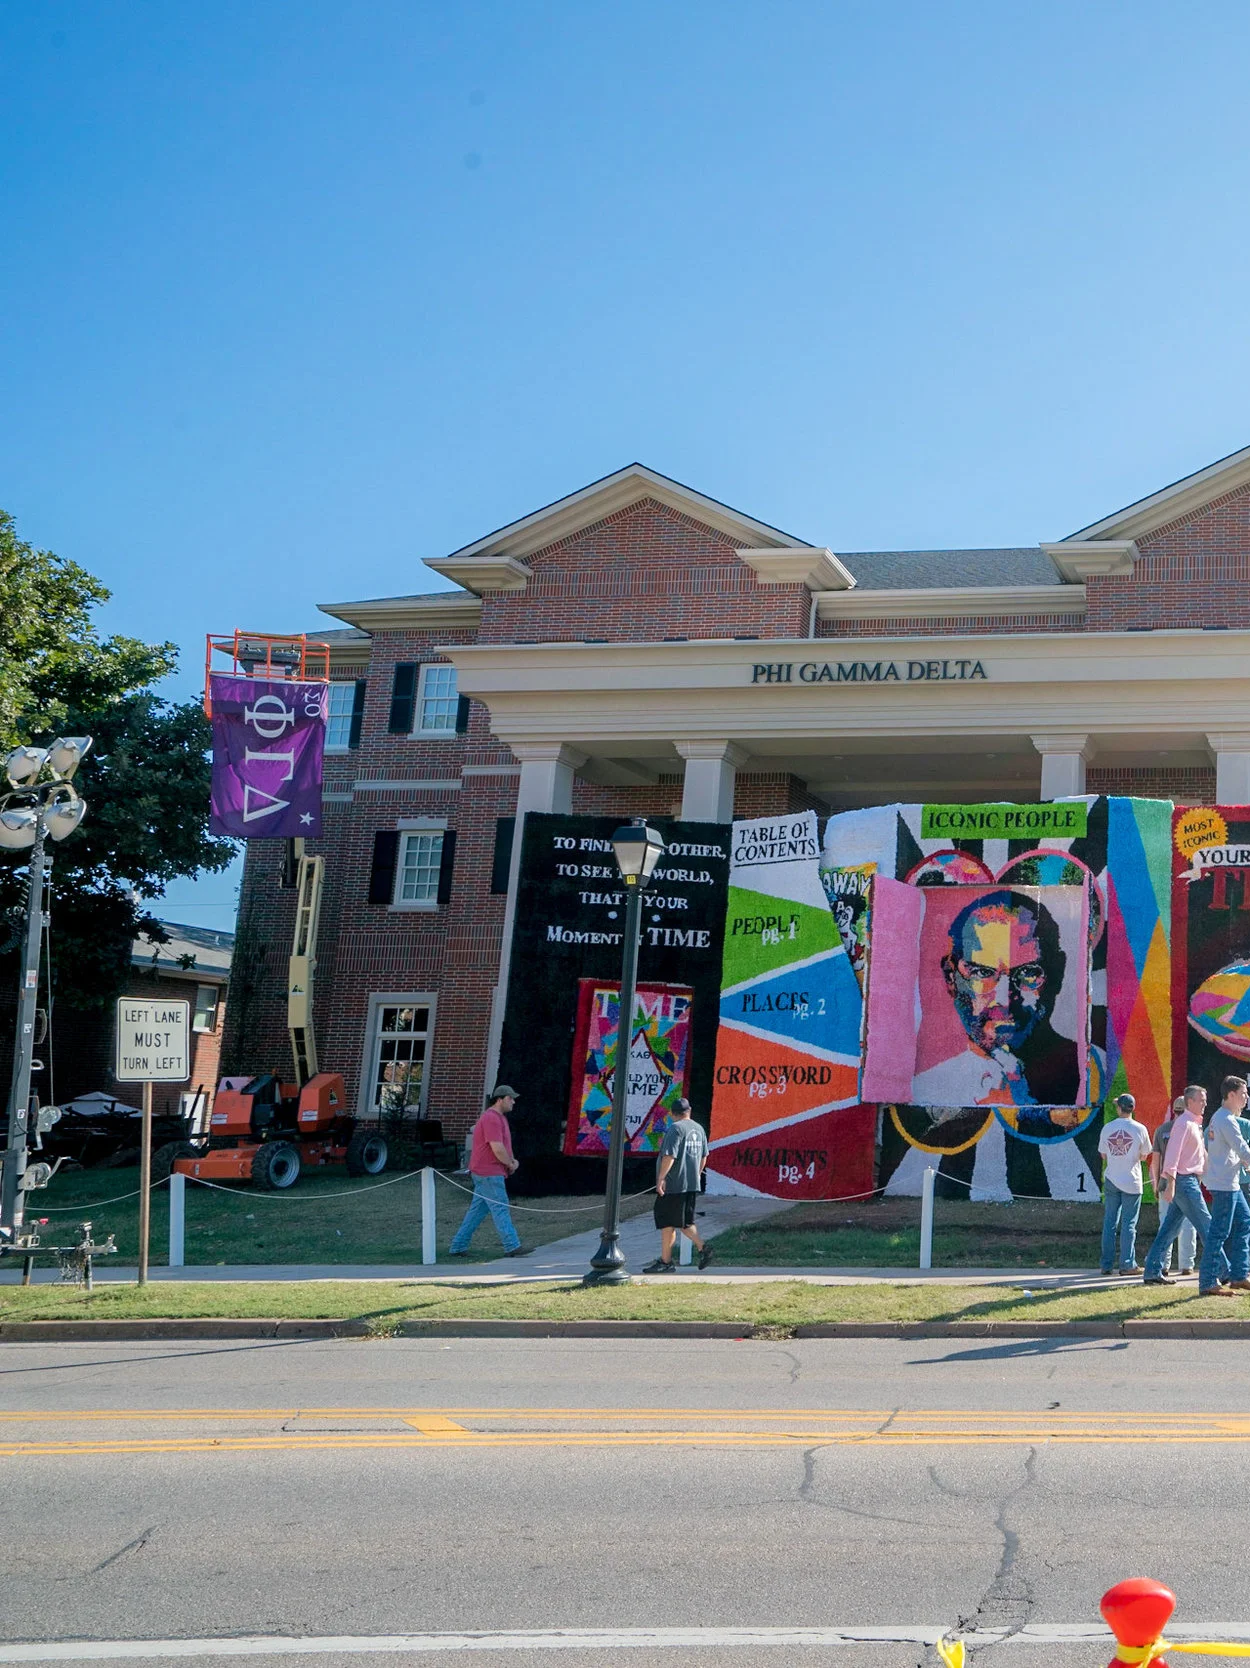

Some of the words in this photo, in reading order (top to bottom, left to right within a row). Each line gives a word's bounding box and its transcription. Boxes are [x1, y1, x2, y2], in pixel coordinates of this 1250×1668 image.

[752, 664, 793, 683] PHI
[799, 661, 900, 682] GAMMA
[906, 660, 987, 680] DELTA
[929, 811, 999, 829] ICONIC
[1004, 810, 1076, 828] PEOPLE
[1184, 818, 1215, 835] MOST
[740, 825, 787, 844] TABLE
[791, 821, 810, 838] OF
[1183, 830, 1221, 848] ICONIC
[553, 837, 576, 850] TO
[668, 843, 727, 860] OTHER,
[735, 838, 815, 862] CONTENTS
[556, 864, 578, 877] TO
[581, 865, 612, 879] SEE
[652, 869, 714, 885] WORLD,
[579, 892, 623, 905] THAT
[644, 896, 689, 910] YOUR
[732, 914, 800, 936] PEOPLE
[647, 927, 710, 948] TIME
[594, 989, 690, 1023] TME
[742, 992, 810, 1013] PLACES
[125, 1010, 149, 1022] LEFT
[154, 1011, 182, 1023] LANE
[134, 1032, 171, 1047] MUST
[123, 1057, 149, 1069] TURN
[156, 1057, 182, 1069] LEFT
[716, 1066, 832, 1085] CROSSWORD
[732, 1148, 827, 1170] MOMENTS
[778, 1164, 803, 1185] pg.
[805, 1162, 815, 1180] 4
[1076, 1172, 1087, 1192] 1
